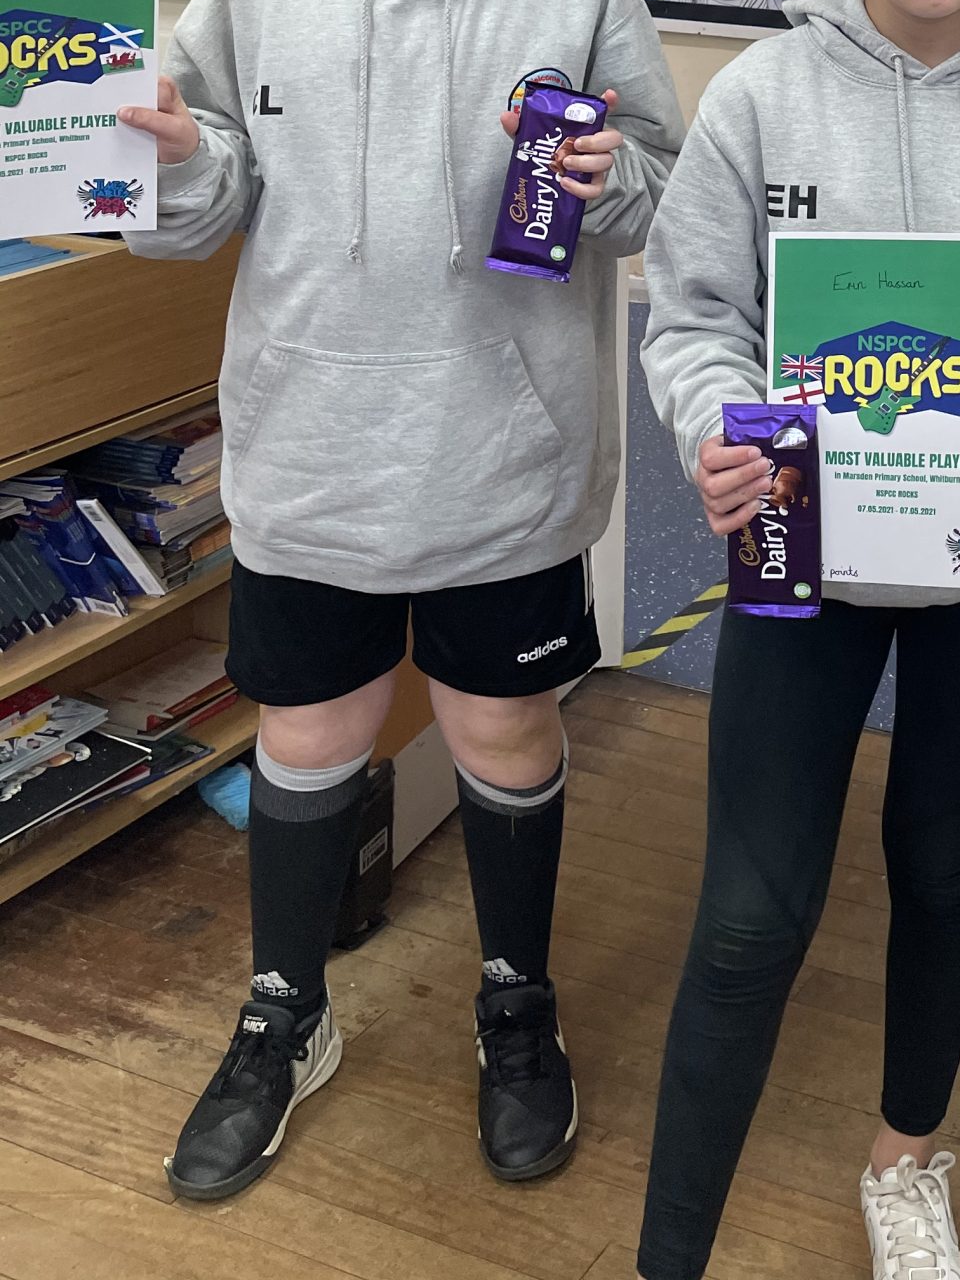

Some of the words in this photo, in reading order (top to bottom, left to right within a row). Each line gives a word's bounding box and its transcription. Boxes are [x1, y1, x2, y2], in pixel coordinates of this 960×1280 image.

[5, 117, 67, 135] VALUABLE
[71, 114, 117, 129] PLAYER
[5, 153, 26, 162] NSPCC
[531, 126, 563, 180] Milk
[509, 177, 529, 224] Cadbury
[524, 174, 559, 241] Dairy
[765, 183, 818, 219] EH
[833, 272, 866, 291] Erin
[878, 271, 925, 290] Hassan
[857, 335, 926, 353] NSPCC
[825, 451, 861, 466] MOST
[864, 452, 925, 468] VALUABLE
[843, 471, 873, 481] Marsden
[874, 472, 901, 483] Primary
[902, 474, 928, 484] School,
[929, 474, 960, 484] Whitburn
[875, 489, 897, 498] NSPCC
[898, 490, 919, 499] ROCKS
[857, 505, 894, 515] 07.05.2021
[899, 506, 937, 516] 07.05.2021
[761, 516, 788, 580] Dairy
[830, 565, 859, 578] points
[517, 636, 568, 663] adidas
